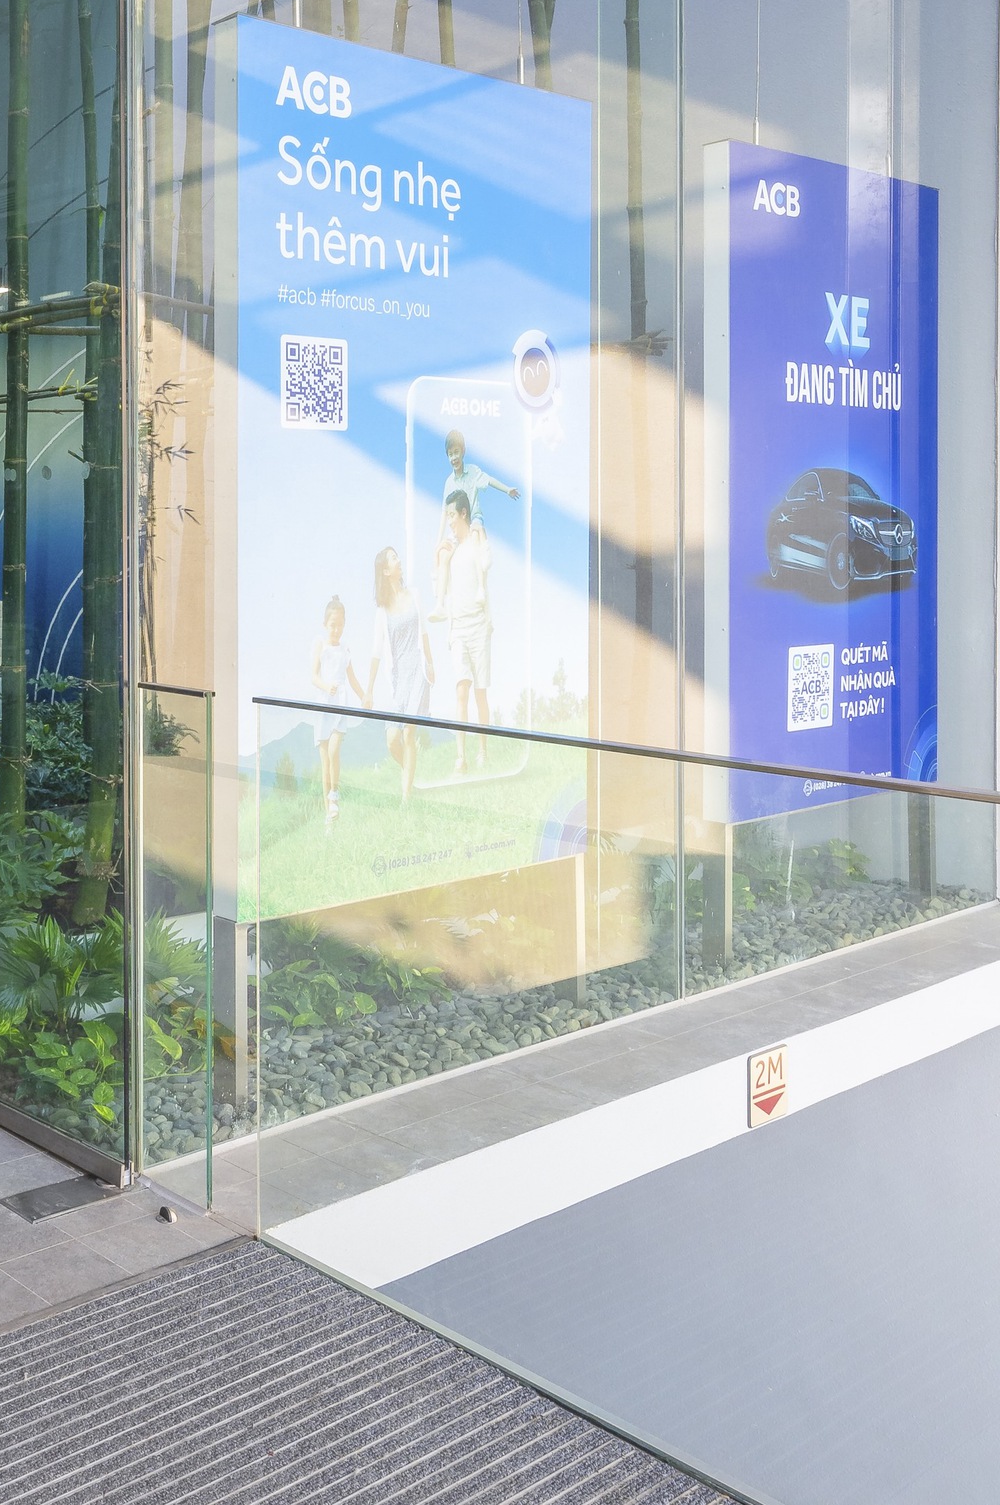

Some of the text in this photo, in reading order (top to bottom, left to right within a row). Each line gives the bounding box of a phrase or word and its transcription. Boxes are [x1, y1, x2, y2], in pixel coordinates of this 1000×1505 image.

[276, 65, 352, 118] ACB
[277, 135, 461, 221] Sống nhẹ
[753, 179, 800, 218] ACB
[275, 212, 449, 278] thêm vui
[278, 284, 431, 320] #acb #forcus_on_you
[825, 291, 870, 351] XE
[785, 358, 902, 411] ĐANG TÌM CHỦ
[841, 641, 888, 665] QUÉT MÃ
[800, 680, 822, 695] ACB
[840, 665, 896, 694] NHẬN QUÀ
[839, 701, 858, 722] TẠI
[389, 856, 409, 870] (028)
[423, 852, 437, 863] 247
[438, 849, 453, 860] 247
[475, 838, 516, 853] acb.com.vn
[755, 1052, 783, 1089] 2M
